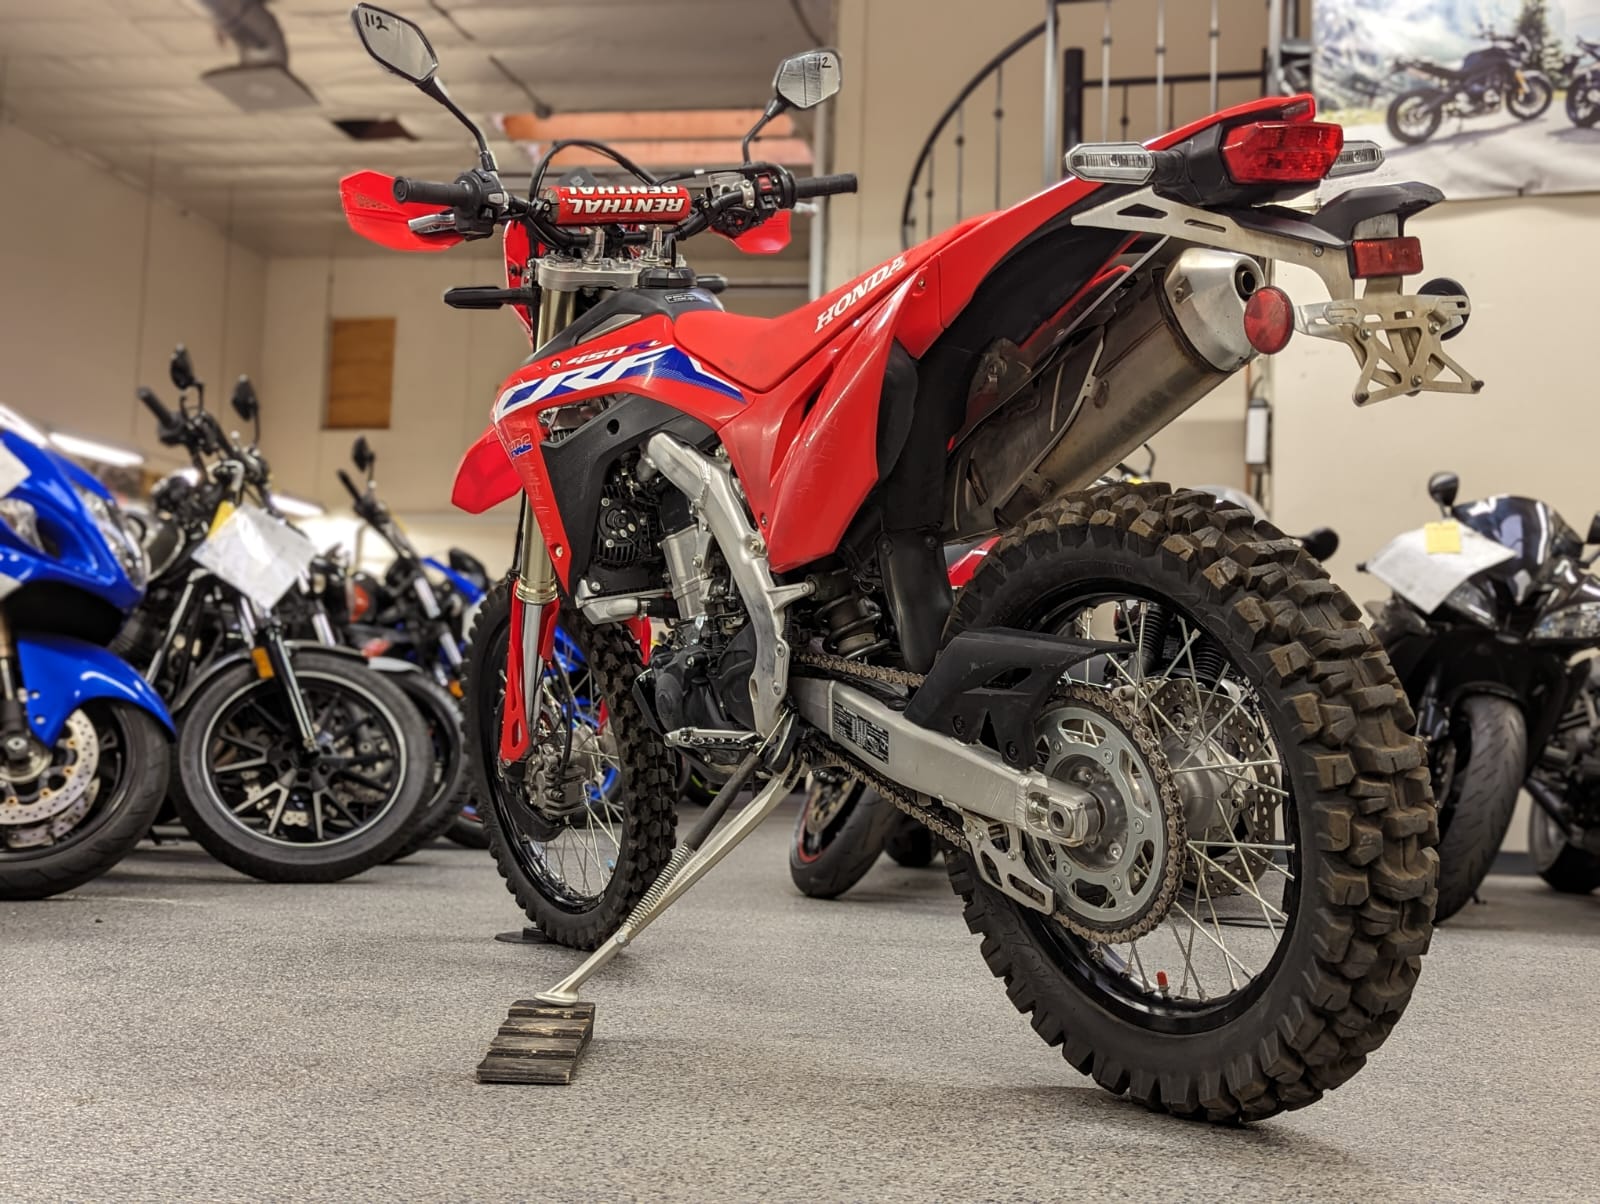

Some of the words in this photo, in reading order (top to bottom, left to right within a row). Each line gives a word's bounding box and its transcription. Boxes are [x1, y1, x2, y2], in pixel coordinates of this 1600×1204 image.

[364, 11, 389, 31] 112
[568, 198, 686, 214] RENTHAL
[814, 255, 907, 334] HONDA
[494, 344, 676, 424] CRF
